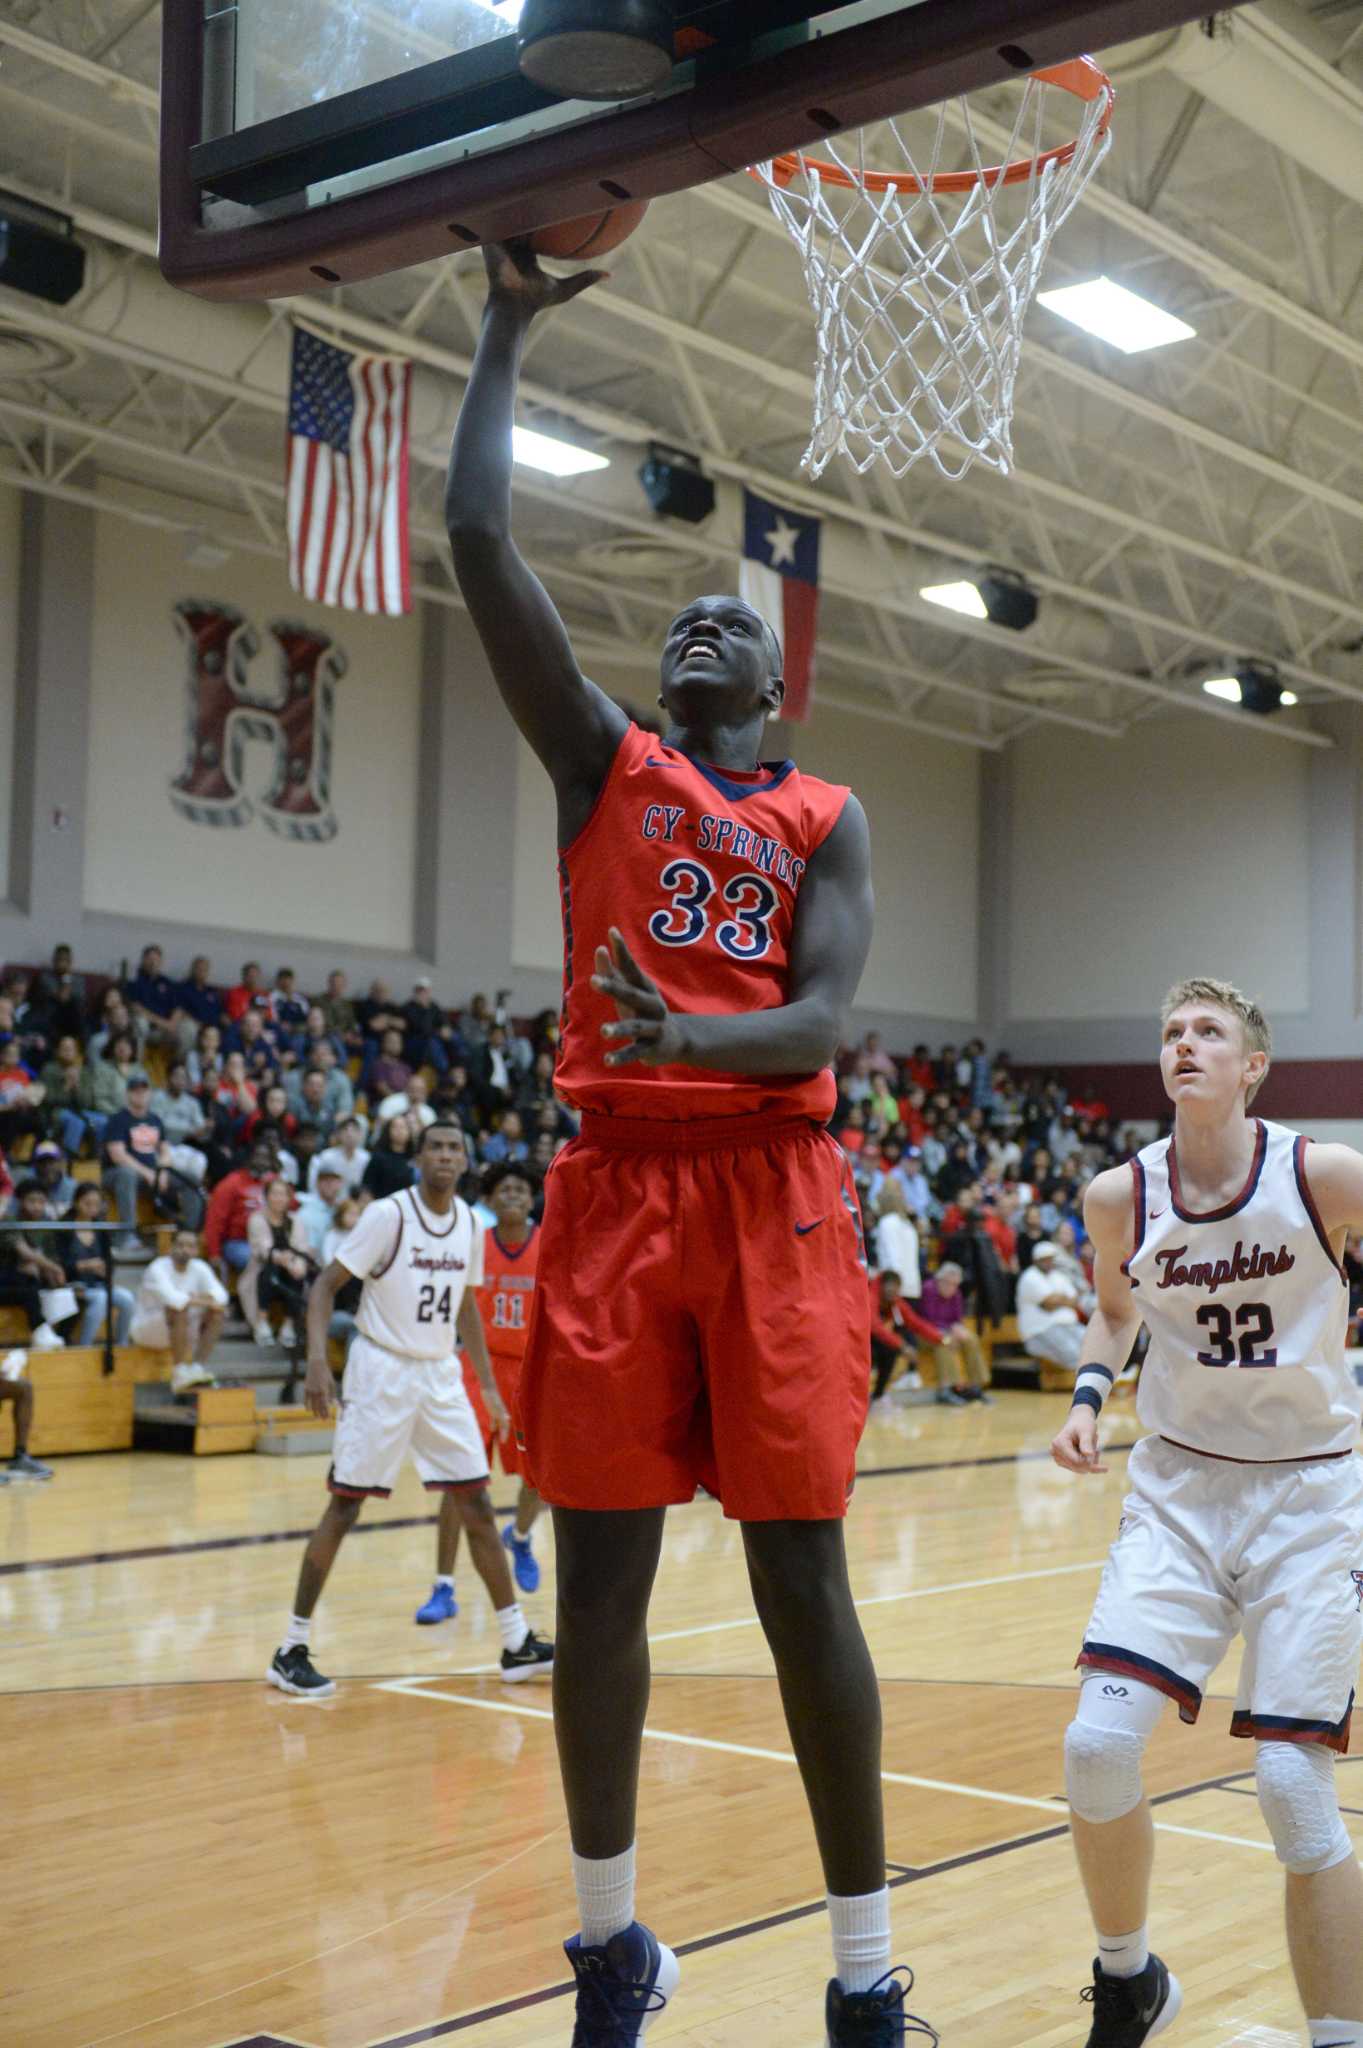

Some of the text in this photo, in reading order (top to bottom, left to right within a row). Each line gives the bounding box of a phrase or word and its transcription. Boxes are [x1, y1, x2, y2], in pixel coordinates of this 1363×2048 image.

[648, 858, 781, 961] 33
[1155, 1240, 1295, 1294] Tompkins
[417, 1284, 452, 1323] 24
[491, 1292, 526, 1329] 11
[1196, 1302, 1278, 1368] 32
